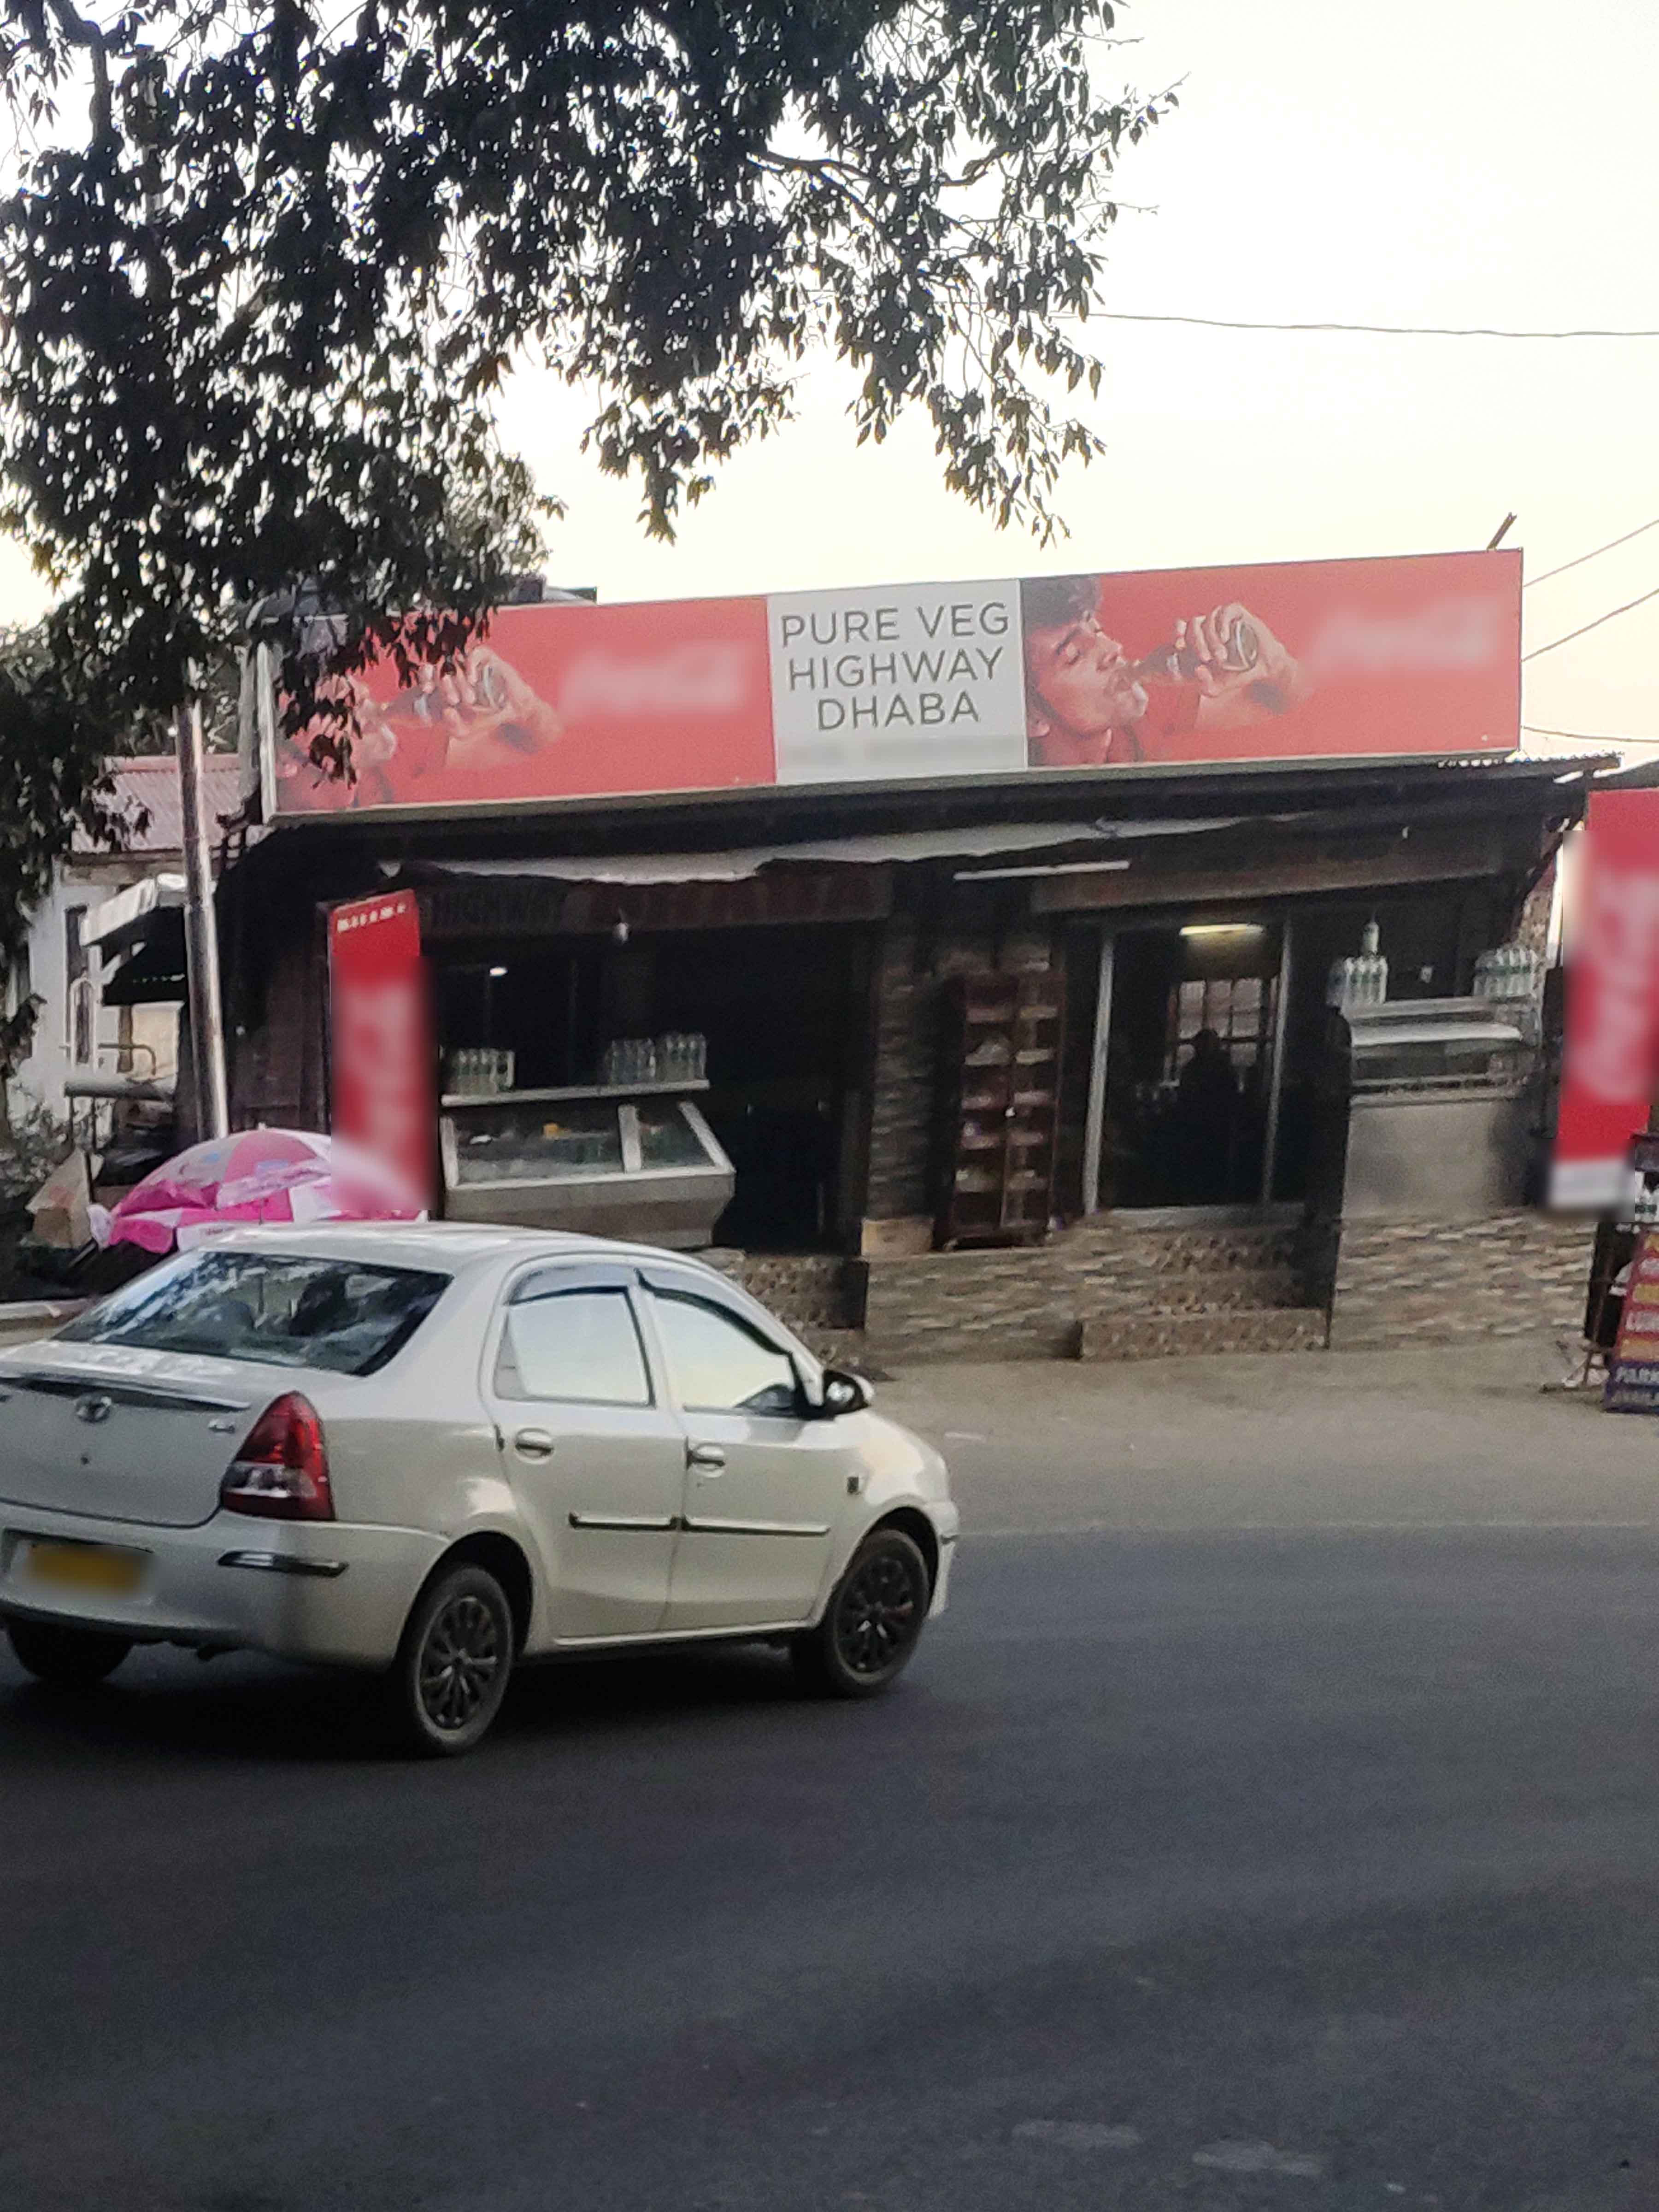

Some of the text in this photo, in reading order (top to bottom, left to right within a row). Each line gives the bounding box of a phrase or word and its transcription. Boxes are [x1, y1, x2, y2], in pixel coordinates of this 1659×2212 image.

[781, 601, 1009, 648] PURE VEG
[788, 646, 1003, 691] HIGHWAY
[817, 691, 980, 731] DHABA
